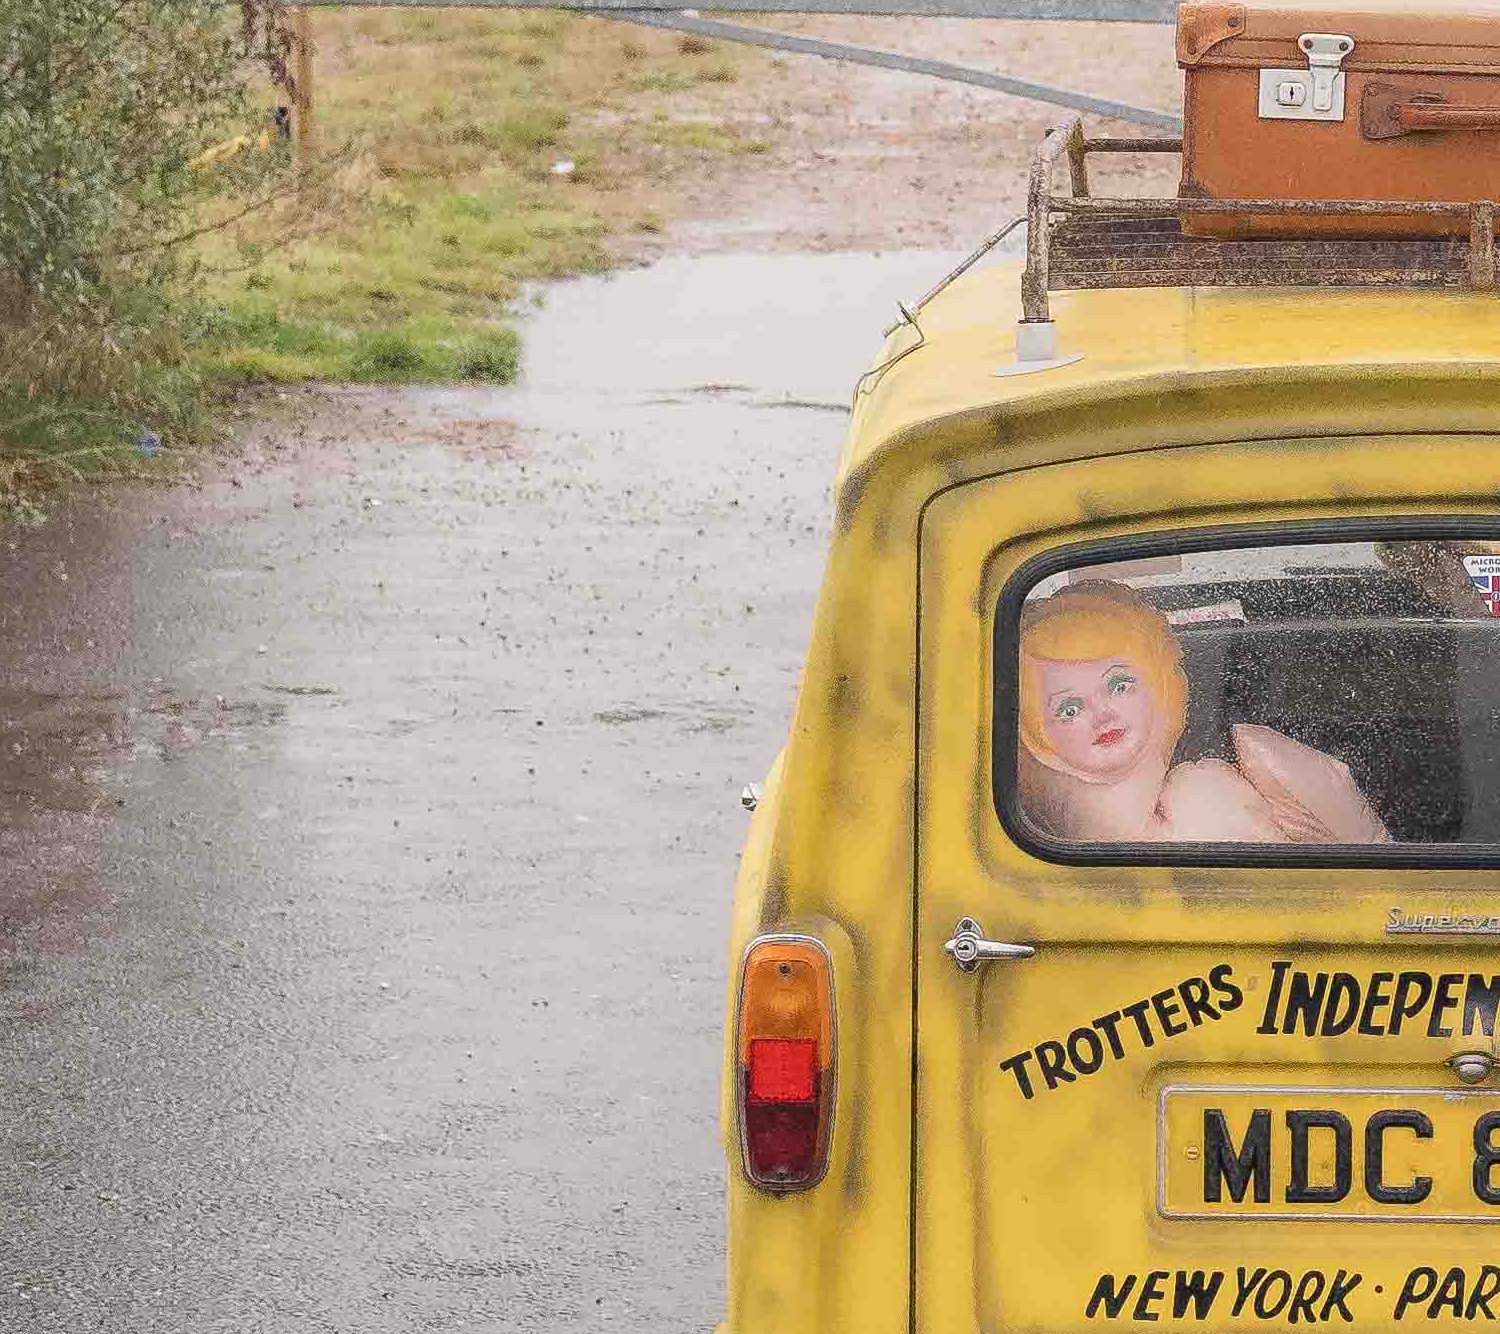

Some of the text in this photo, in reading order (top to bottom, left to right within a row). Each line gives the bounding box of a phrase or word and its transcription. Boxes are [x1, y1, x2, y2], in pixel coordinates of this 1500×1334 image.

[999, 963, 1244, 1100] TROTTERS
[1203, 1108, 1434, 1204] MDC
[1084, 1269, 1225, 1322] NEW
[1230, 1266, 1363, 1324] YORK
